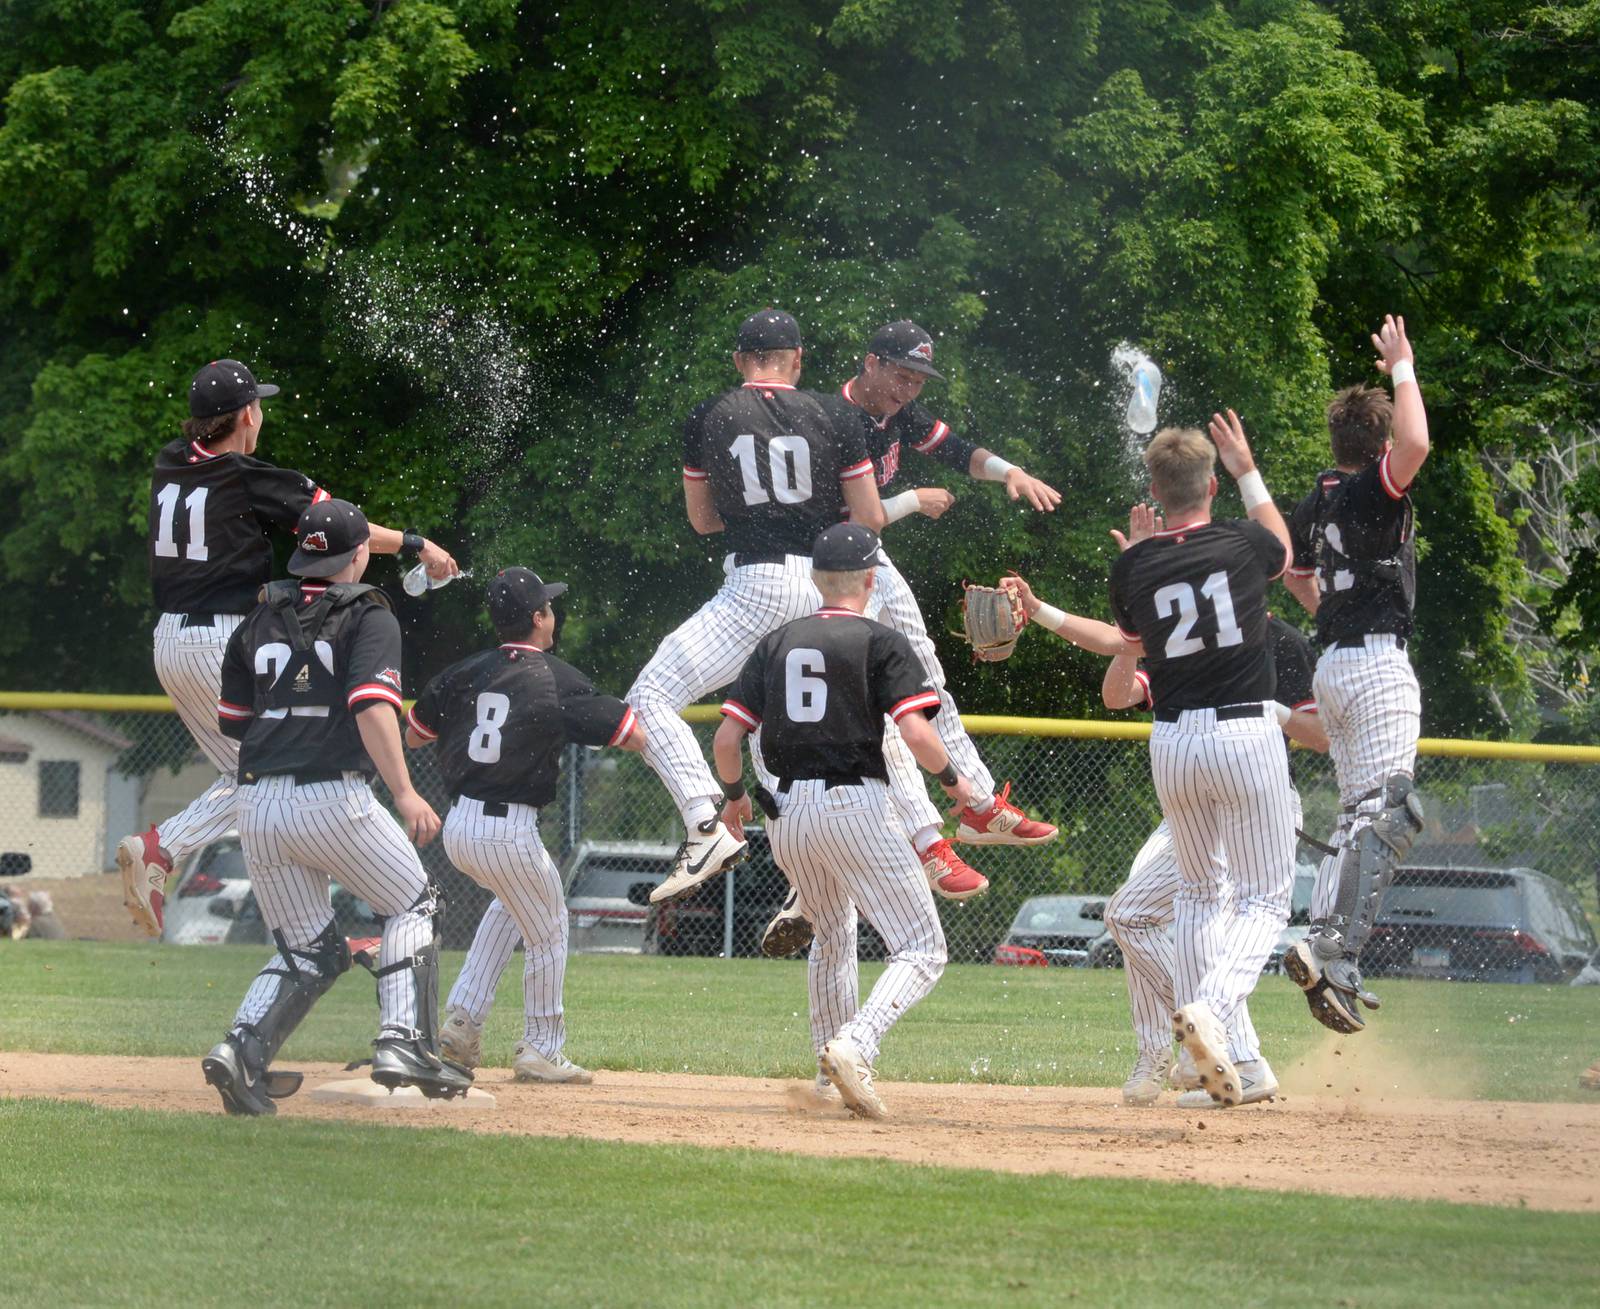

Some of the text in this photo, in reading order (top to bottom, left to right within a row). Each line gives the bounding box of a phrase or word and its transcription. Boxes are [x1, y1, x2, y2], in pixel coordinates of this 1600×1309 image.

[728, 434, 813, 506] 10
[154, 483, 208, 561] 11
[1153, 571, 1244, 659] 21
[785, 648, 827, 722] 6
[468, 692, 510, 763] 8
